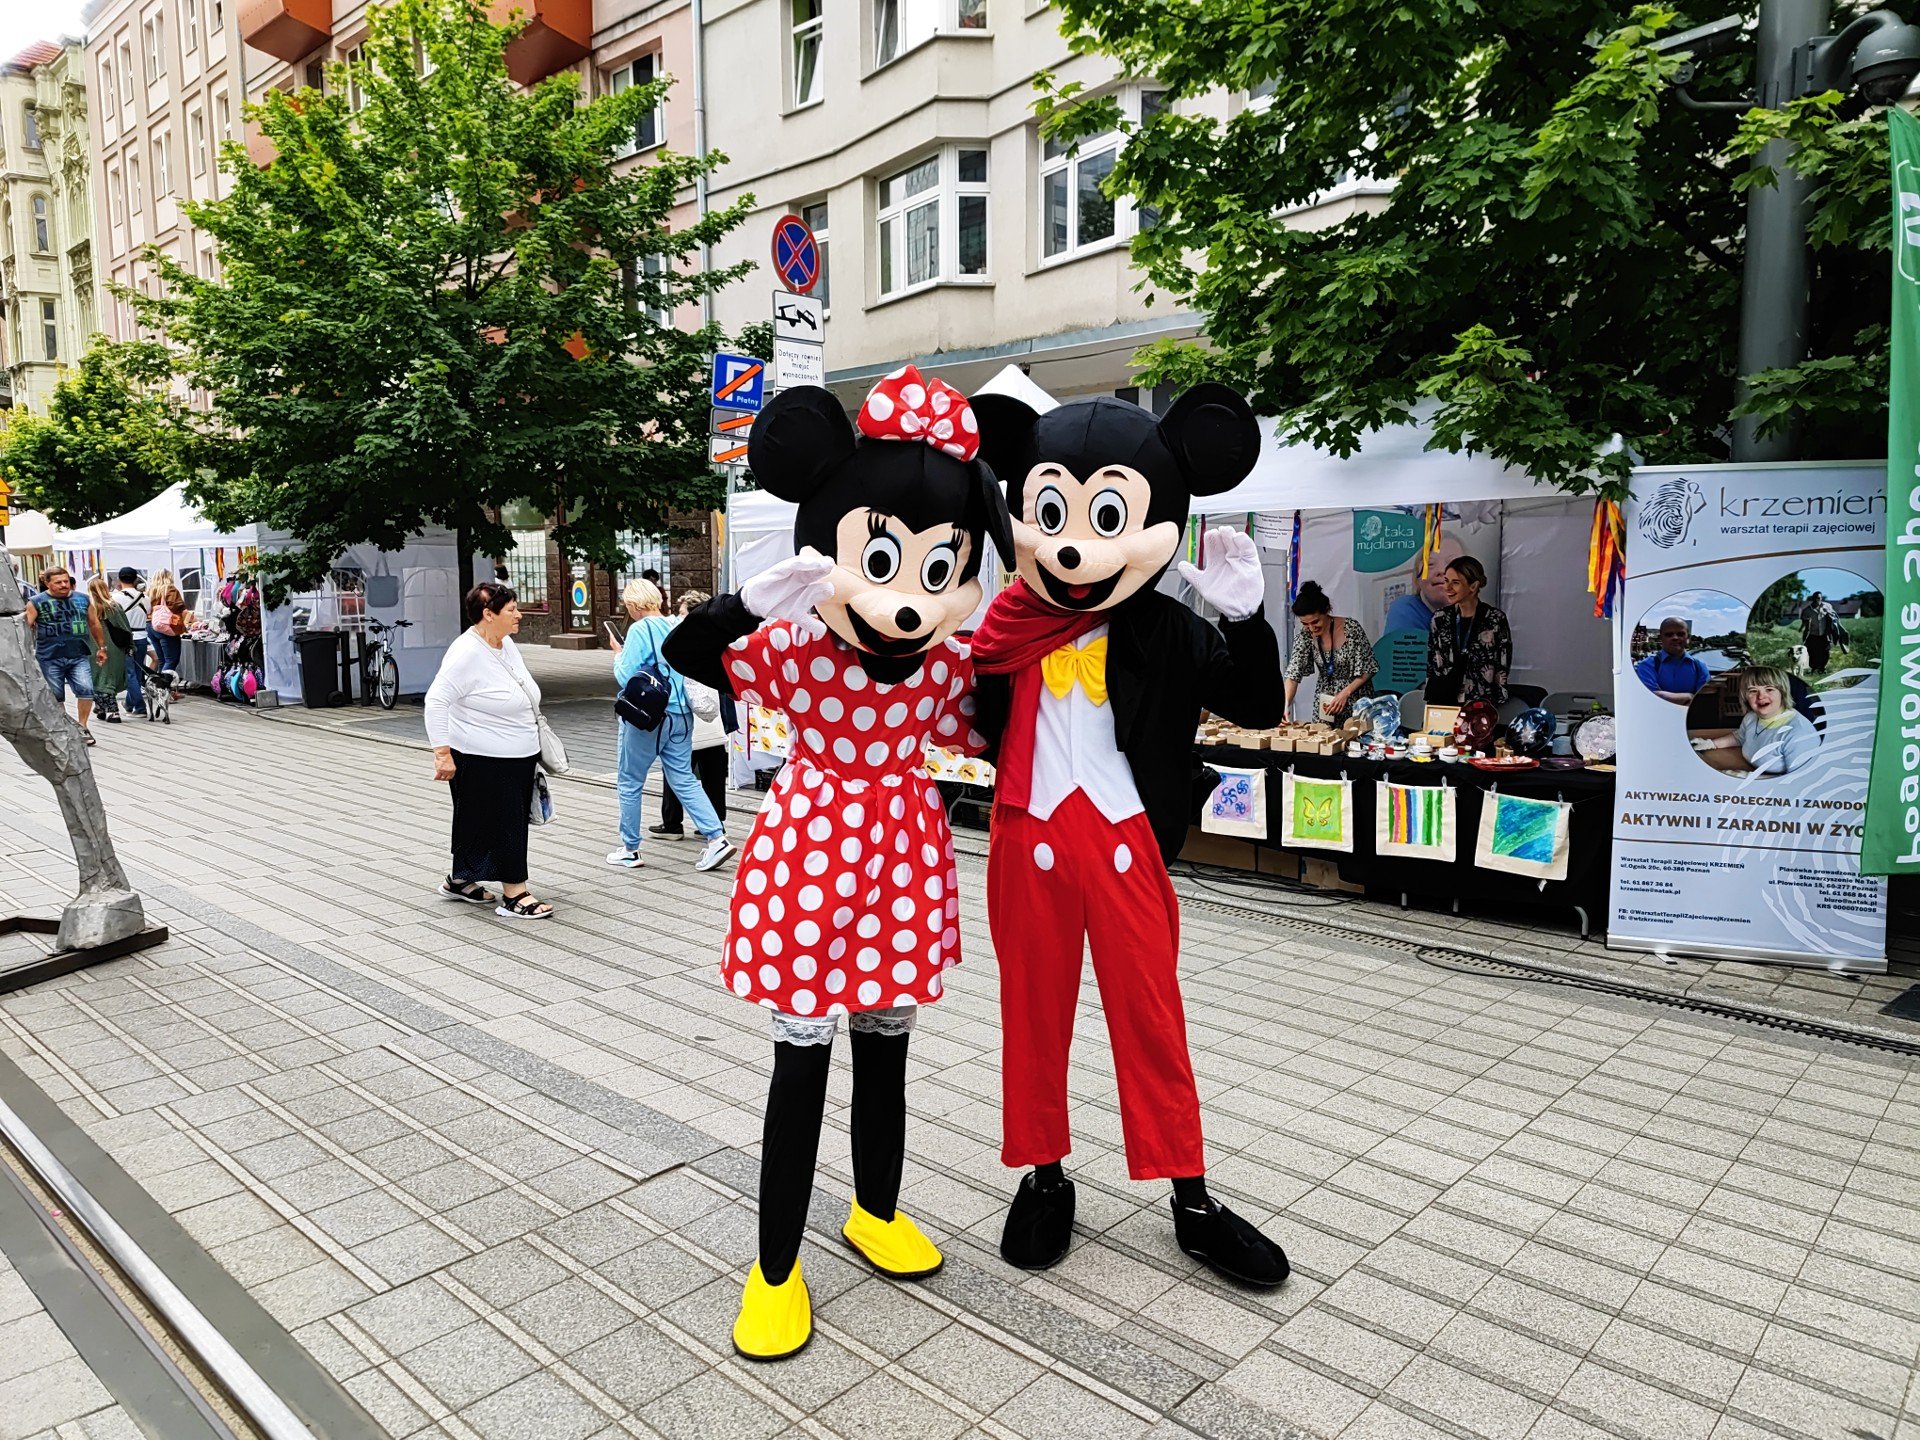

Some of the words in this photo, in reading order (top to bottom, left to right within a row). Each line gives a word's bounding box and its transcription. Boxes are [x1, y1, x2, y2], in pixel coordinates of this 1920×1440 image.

[1720, 487, 1887, 517] krzemień
[1384, 524, 1414, 537] taka
[1721, 525, 1769, 534] warsztat
[1773, 523, 1809, 534] terapii
[1812, 522, 1875, 534] zajęciowej
[1625, 791, 1710, 803] AKTYWIZACJA
[1713, 795, 1791, 807] SPOŁECZNA
[1795, 799, 1800, 807] I
[1803, 799, 1867, 810] ZAWODO
[1620, 813, 1701, 828] AKTYWNI
[1706, 817, 1711, 828] I
[1717, 818, 1800, 834] ZARADNI
[1807, 823, 1825, 835] W
[1620, 856, 1649, 864] Warsztat
[1651, 858, 1672, 866] Terapii
[1709, 861, 1745, 869] KRZEMIEŃ
[1799, 874, 1853, 883] Stowarzyszenie
